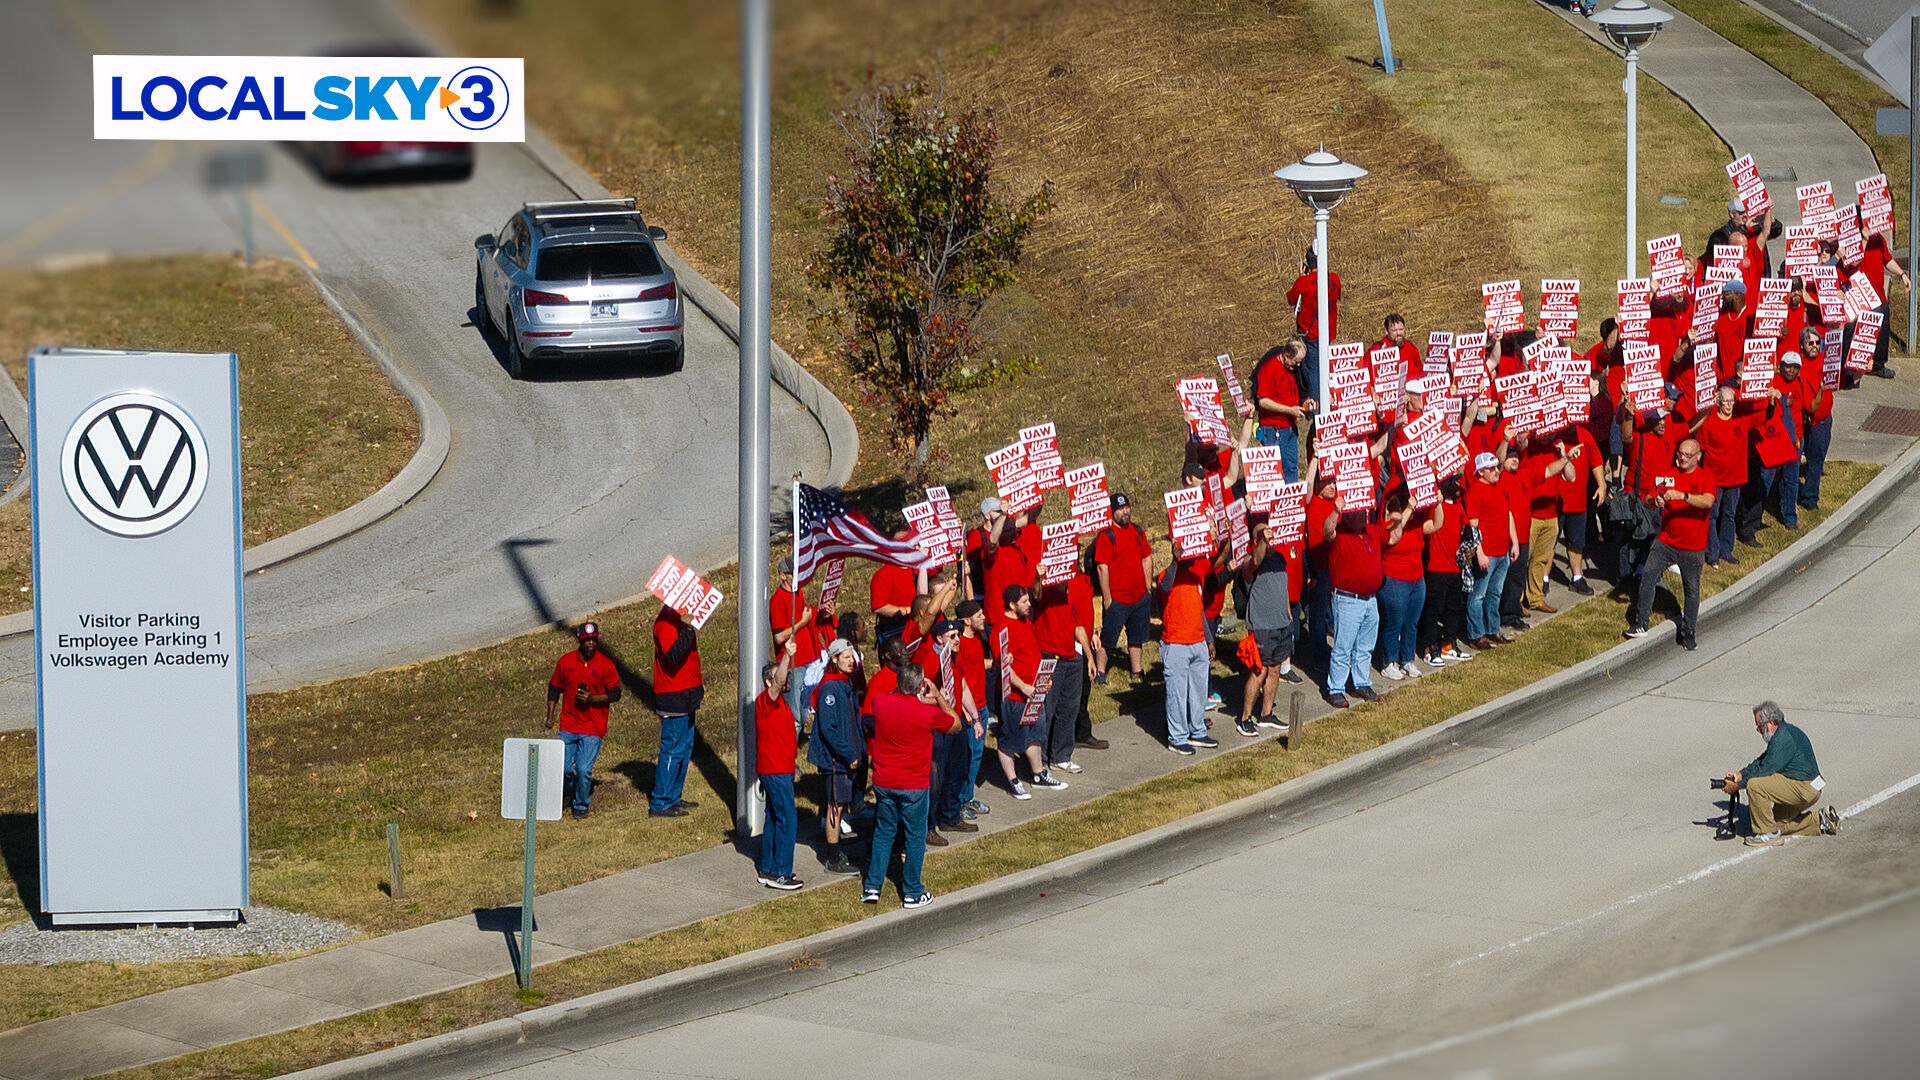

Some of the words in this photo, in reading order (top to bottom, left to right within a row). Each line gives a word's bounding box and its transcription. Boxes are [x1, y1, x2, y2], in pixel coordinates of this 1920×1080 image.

[1729, 156, 1749, 172] UAW
[1800, 184, 1826, 196] UAW
[1859, 176, 1881, 190] UAW
[1804, 194, 1829, 210] JUST
[1835, 206, 1852, 219] UAW
[1790, 227, 1814, 236] UAW
[1651, 237, 1675, 250] UAW
[1790, 238, 1814, 250] JUST
[1654, 248, 1678, 264] JUST
[1710, 270, 1736, 279] UAW
[1486, 282, 1514, 292] UAW
[1621, 280, 1646, 290] UAW
[1658, 274, 1682, 290] JUST
[1764, 281, 1788, 289] UAW
[1699, 284, 1719, 296] UAW
[1763, 292, 1787, 302] JUST
[1546, 293, 1574, 304] JUST
[1622, 292, 1646, 305] JUST
[1544, 319, 1573, 330] JUST
[1623, 319, 1647, 331] JUST
[1758, 318, 1783, 328] JUST
[1862, 313, 1880, 323] UAW
[1432, 334, 1449, 342] UAW
[1460, 334, 1483, 346] UAW
[1331, 346, 1359, 356] UAW
[1528, 338, 1553, 356] UAW
[1696, 345, 1712, 359] UAW
[1748, 341, 1772, 350] UAW
[1374, 350, 1395, 361] UAW
[1460, 347, 1482, 360] JUST
[1544, 350, 1567, 359] UAW
[1627, 348, 1654, 360] UAW
[1748, 352, 1772, 364] JUST
[1333, 359, 1361, 372] JUST
[1377, 361, 1397, 376] JUST
[1630, 360, 1657, 375] JUST
[1336, 370, 1364, 384] UAW
[1423, 377, 1446, 389] UAW
[1458, 375, 1480, 387] JUST
[1499, 374, 1529, 387] UAW
[1340, 383, 1367, 400] JUST
[1745, 379, 1770, 391] JUST
[1504, 385, 1532, 402] JUST
[1634, 388, 1660, 403] JUST
[1318, 412, 1341, 425] UAW
[1345, 412, 1371, 427] JUST
[1407, 411, 1436, 433] UAW
[1510, 410, 1539, 427] JUST
[1024, 425, 1049, 439] UAW
[1320, 424, 1342, 440] JUST
[1028, 438, 1053, 455] JUST
[1245, 448, 1275, 459] UAW
[1334, 444, 1362, 458] UAW
[1401, 442, 1422, 456] UAW
[989, 444, 1018, 464] UAW
[1434, 445, 1461, 470] JUST
[996, 456, 1025, 479] JUST
[1248, 461, 1277, 475] JUST
[1338, 457, 1365, 473] JUST
[1406, 455, 1427, 472] JUST
[1068, 464, 1098, 482] UAW
[1007, 484, 1036, 506] JUST
[1073, 478, 1102, 498] JUST
[1275, 484, 1302, 496] UAW
[1343, 487, 1370, 502] JUST
[1414, 483, 1435, 500] JUST
[1168, 489, 1197, 503] UAW
[1274, 496, 1302, 511] JUST
[906, 504, 928, 518] UAW
[1079, 508, 1107, 525] JUST
[1173, 502, 1201, 520] JUST
[915, 516, 936, 532] JUST
[1047, 522, 1075, 536] UAW
[1272, 522, 1301, 538] JUST
[1047, 533, 1075, 550] JUST
[1180, 532, 1207, 549] JUST
[929, 542, 950, 559] JUST
[1045, 561, 1074, 577] JUST
[657, 565, 680, 597] JUST
[681, 584, 704, 616] JUST
[694, 594, 718, 623] UAW
[79, 614, 131, 628] Visitor
[138, 613, 200, 629] Parking
[59, 634, 138, 650] Employee
[145, 633, 206, 648] Parking
[214, 632, 221, 644] 1
[50, 654, 147, 669] Volkswagen
[154, 652, 229, 667] Academy
